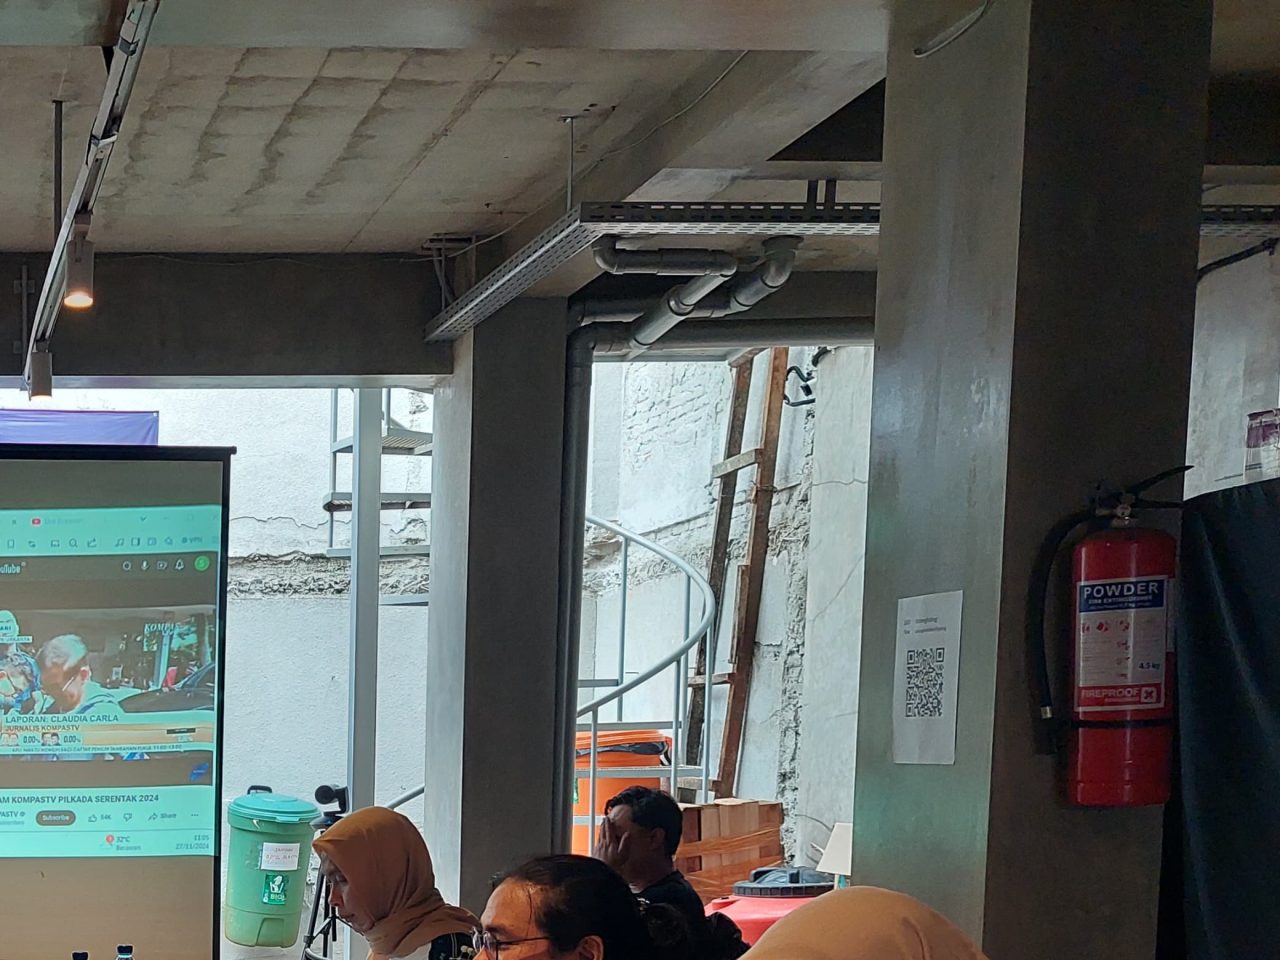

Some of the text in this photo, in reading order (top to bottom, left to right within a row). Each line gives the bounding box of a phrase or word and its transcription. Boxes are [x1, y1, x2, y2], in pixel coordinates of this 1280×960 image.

[1083, 582, 1159, 598] POWDER
[1081, 688, 1140, 698] FIREPROOF
[51, 715, 87, 723] CLAUDIA
[90, 714, 119, 723] CARLA
[11, 796, 57, 804] KOMPASTV
[58, 795, 94, 803] PILKADA
[95, 795, 137, 803] SERENTAK
[138, 794, 159, 802] 2024
